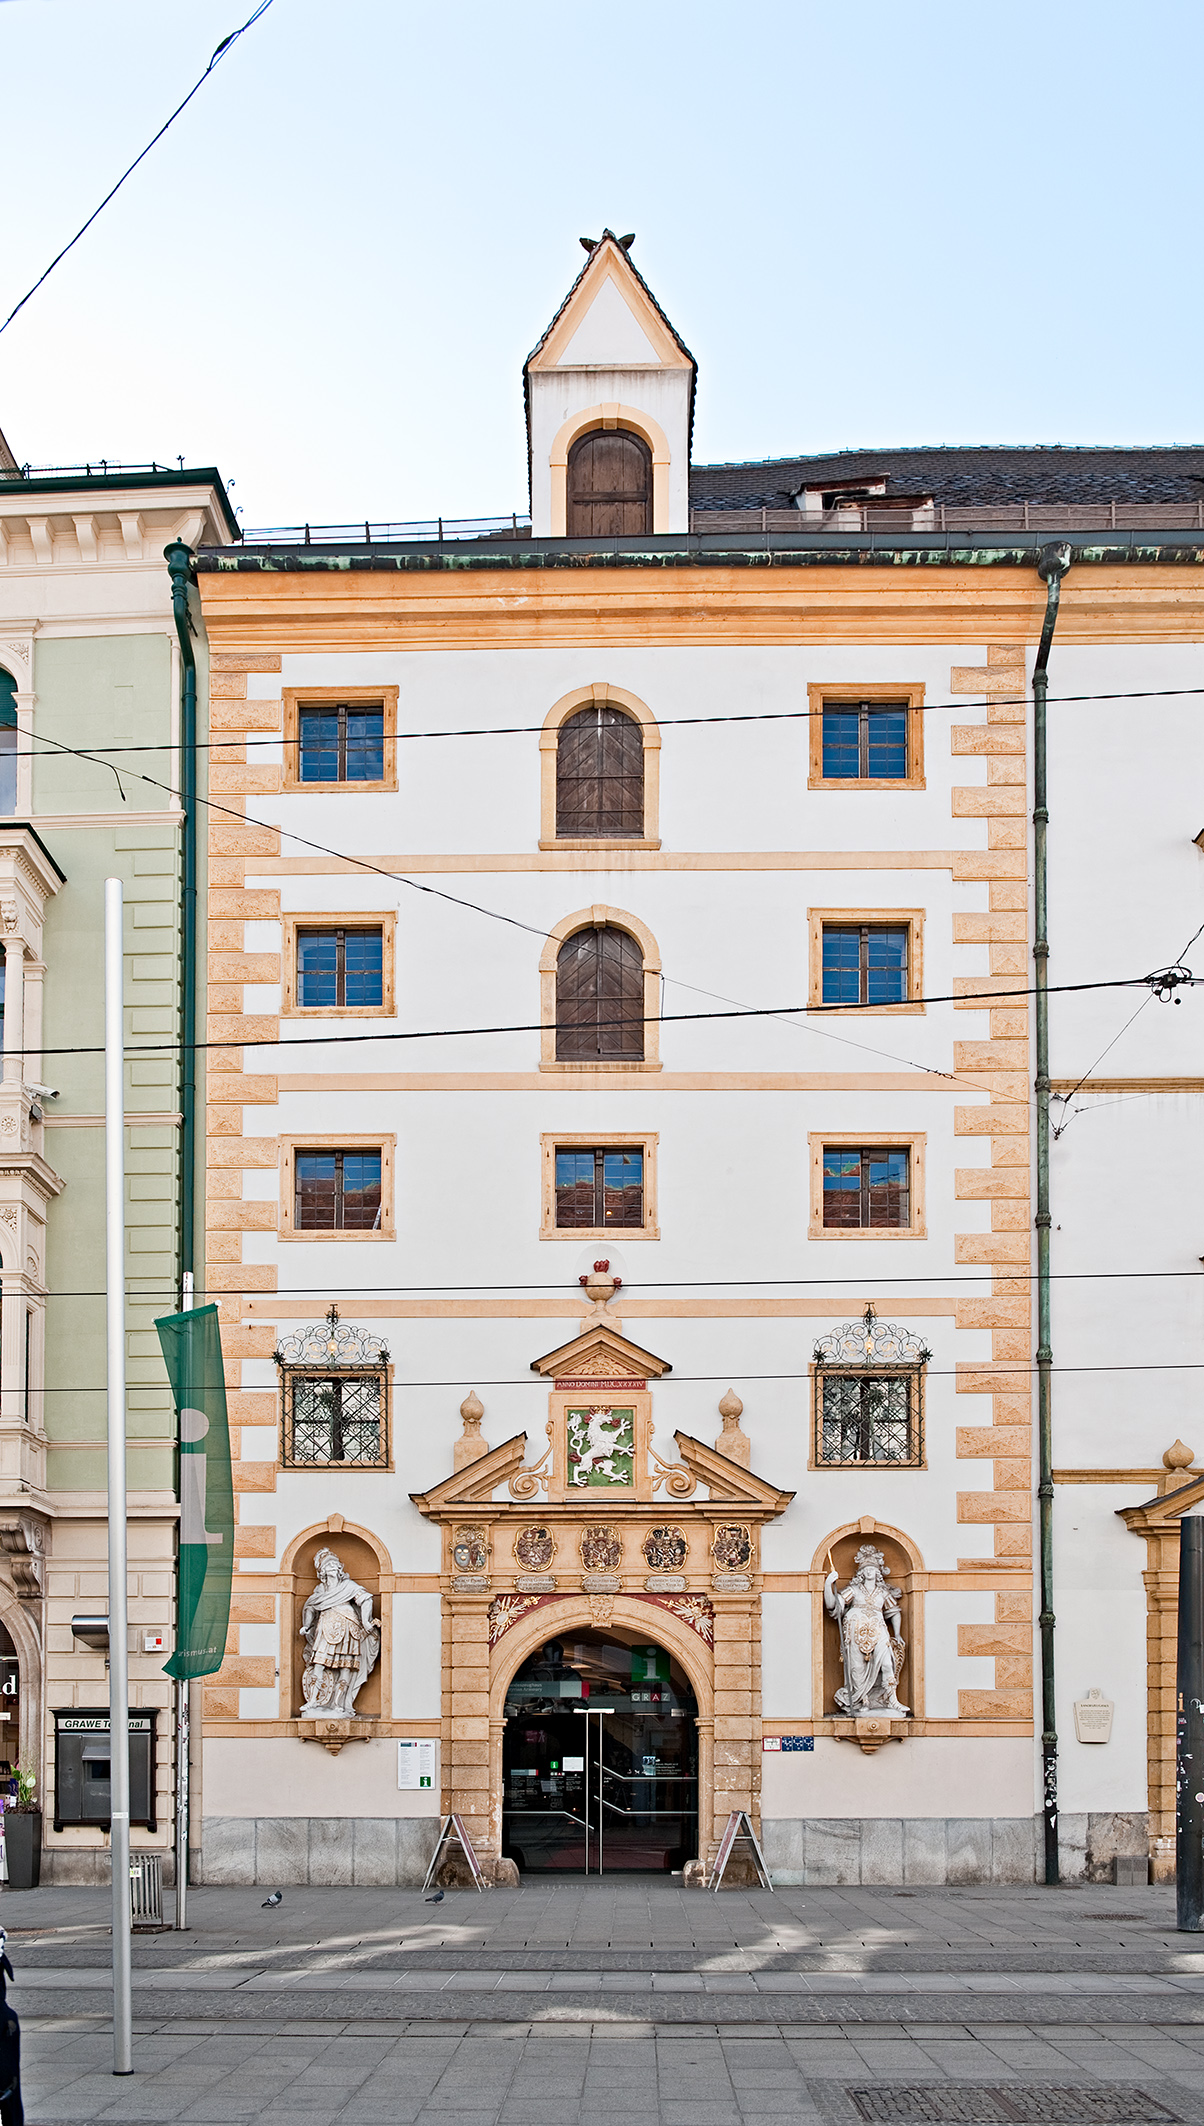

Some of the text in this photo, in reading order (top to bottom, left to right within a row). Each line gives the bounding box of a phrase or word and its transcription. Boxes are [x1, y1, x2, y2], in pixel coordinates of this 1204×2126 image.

[631, 1692, 670, 1701] GRAZ
[64, 1719, 144, 1729] GRAWE Tnal
